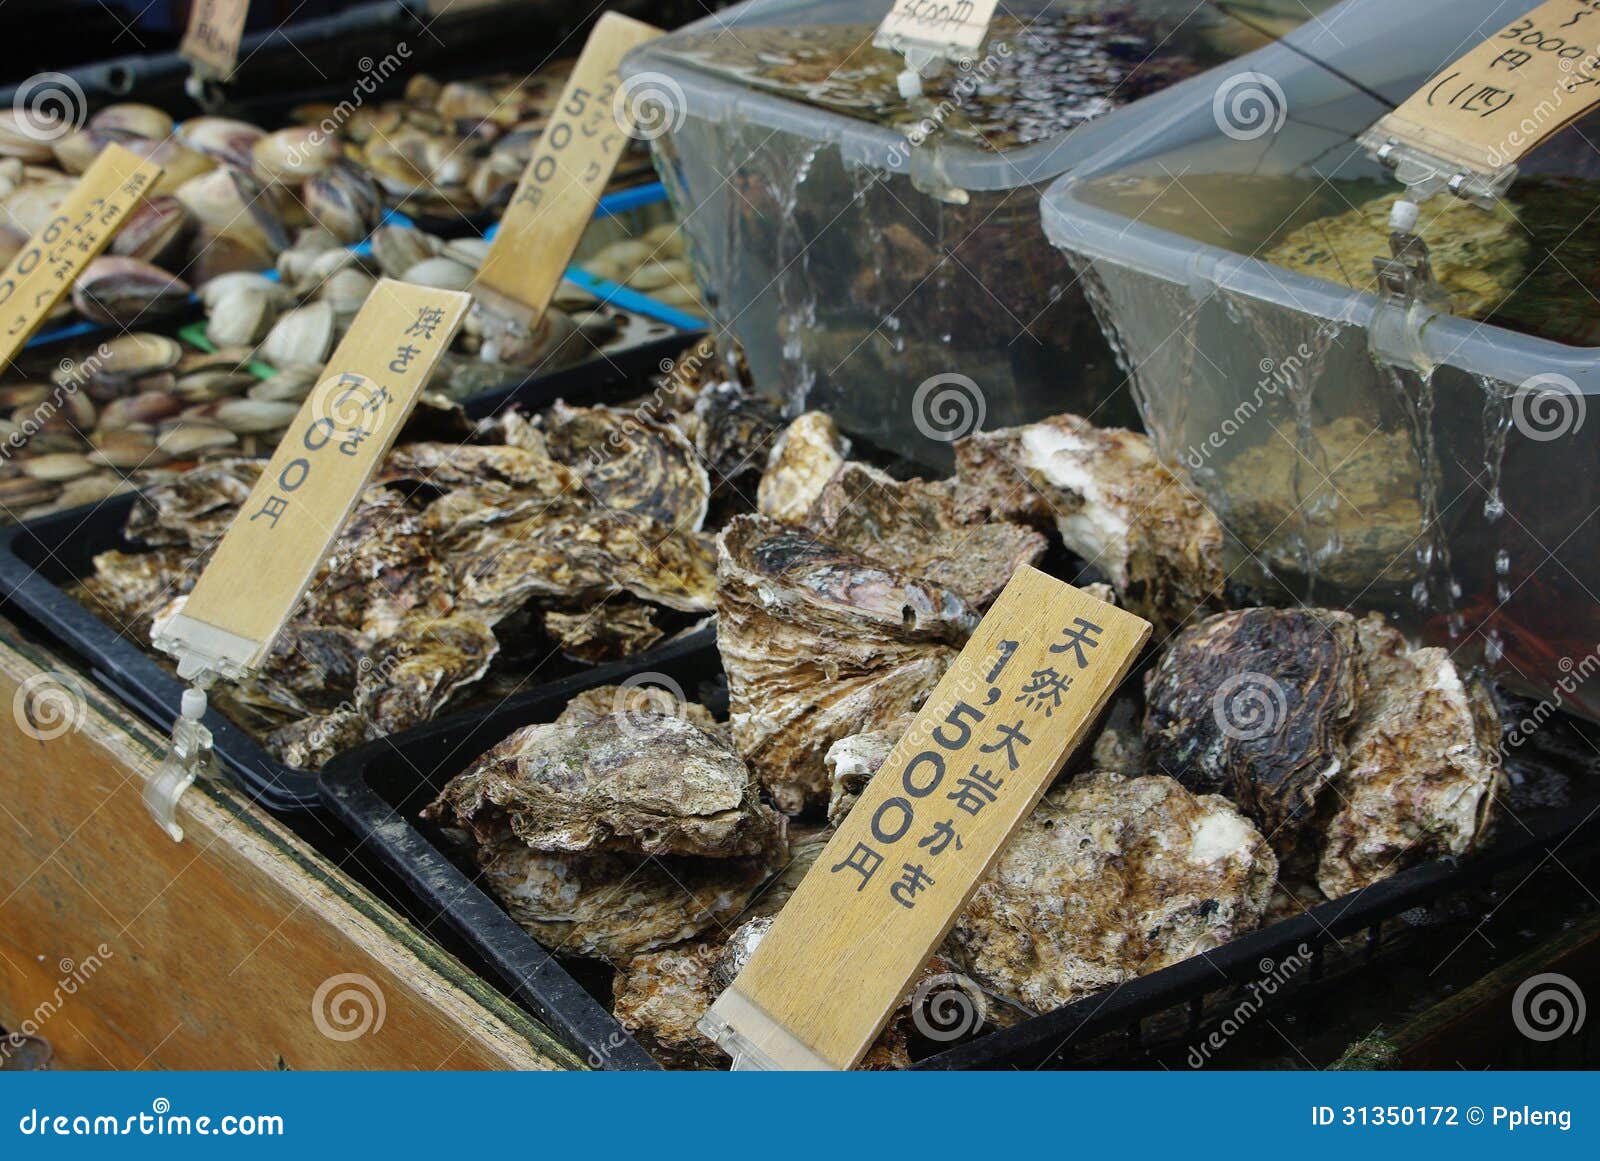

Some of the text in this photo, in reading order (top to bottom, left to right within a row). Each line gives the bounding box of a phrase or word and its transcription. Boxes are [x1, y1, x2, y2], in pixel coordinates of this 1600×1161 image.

[250, 372, 365, 529] 700円
[831, 640, 1019, 892] 1,500円
[890, 617, 1104, 909] 天然大岩かき
